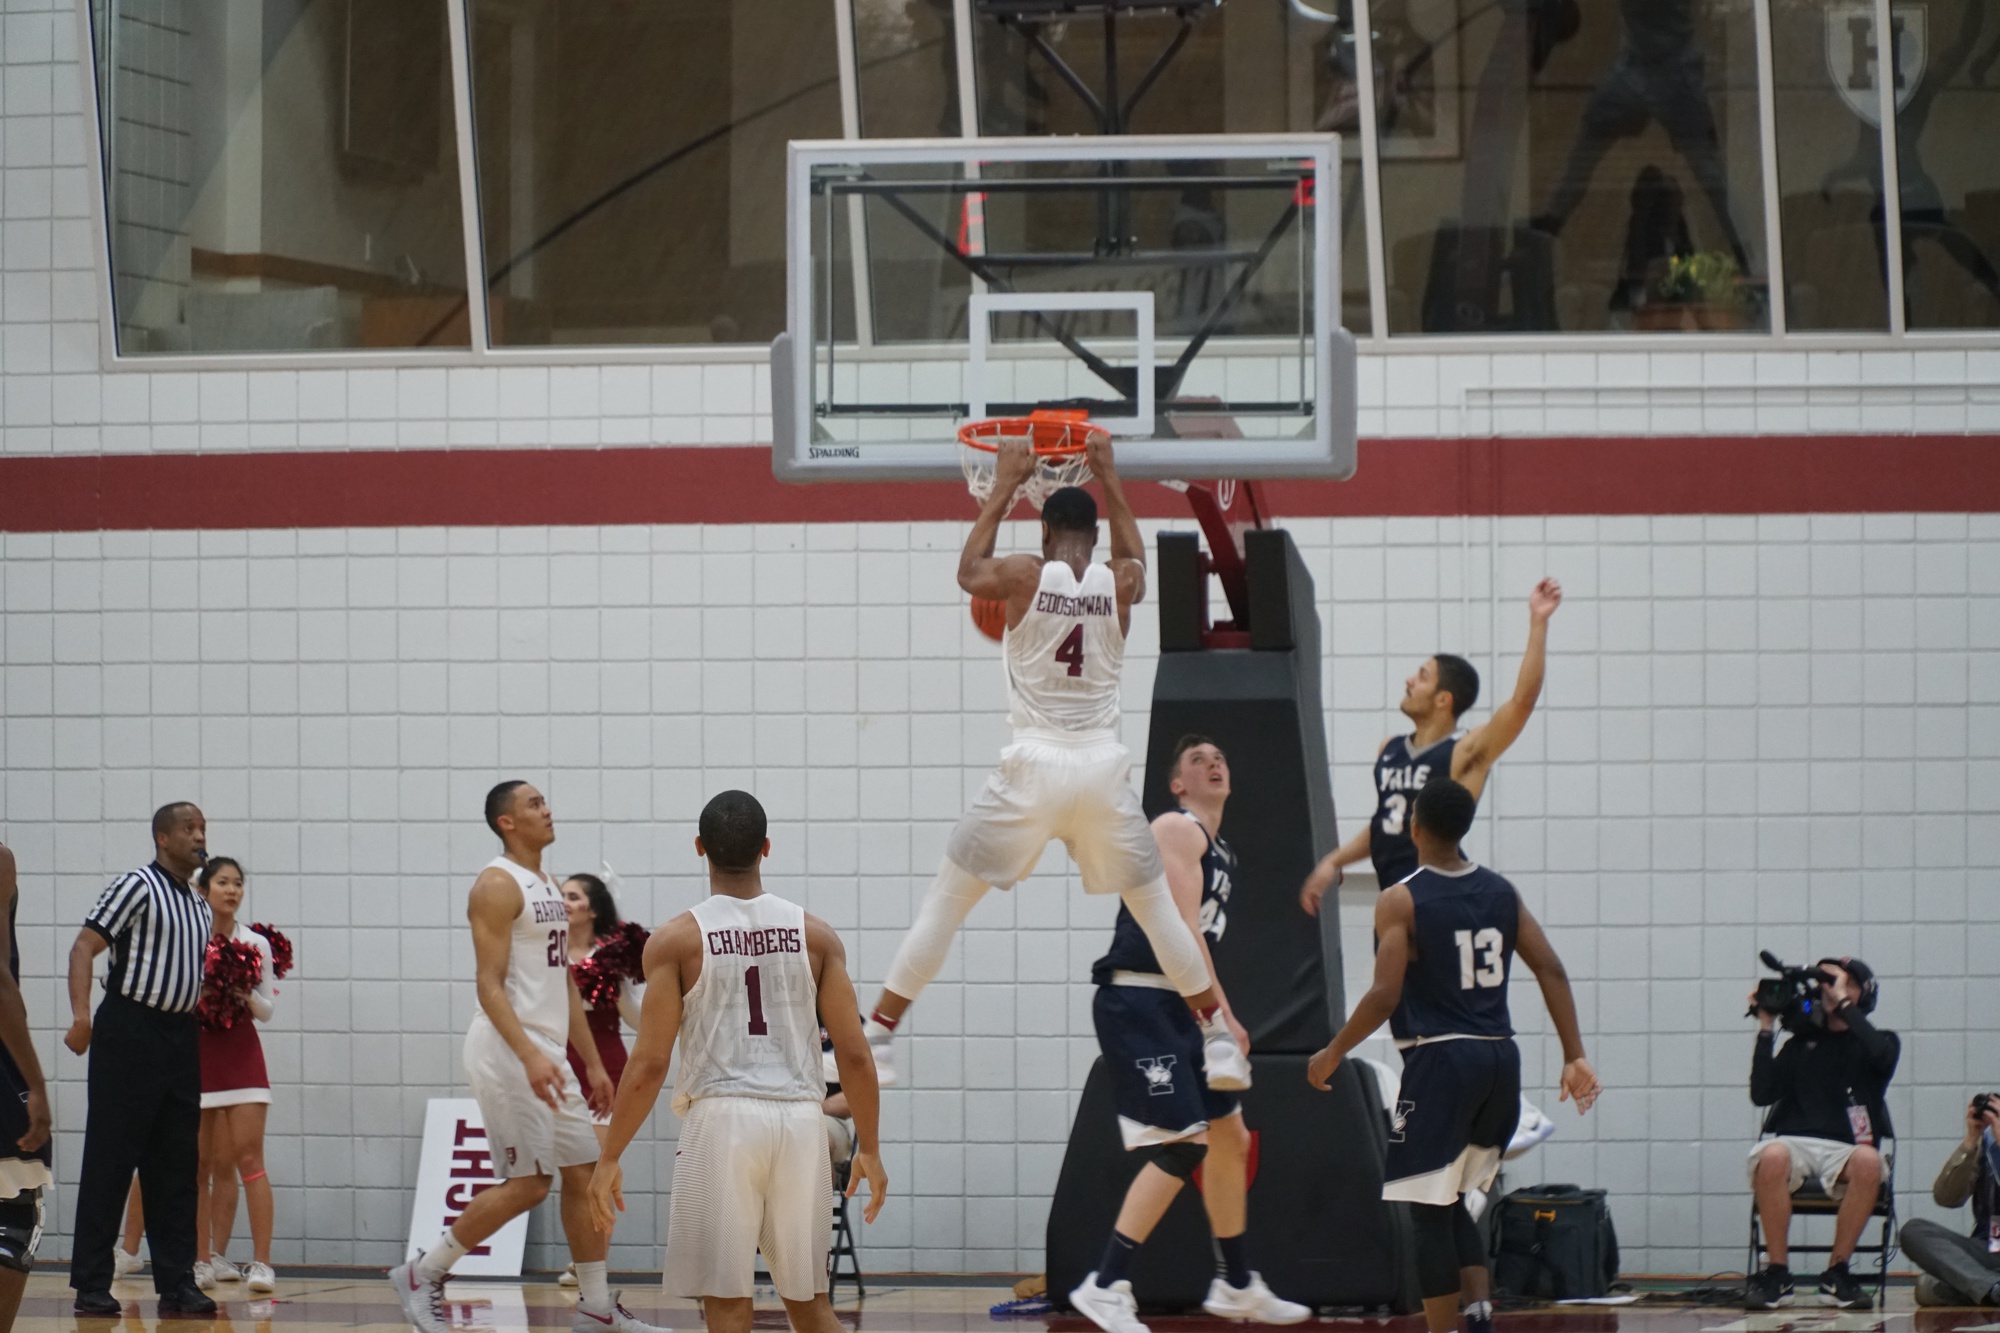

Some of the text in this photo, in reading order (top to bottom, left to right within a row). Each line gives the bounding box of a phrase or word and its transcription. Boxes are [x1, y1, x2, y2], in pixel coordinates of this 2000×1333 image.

[809, 447, 859, 459] SPALDING
[1055, 623, 1084, 677] 4
[1380, 764, 1431, 792] YALE
[707, 928, 801, 956] CHAMBERS
[1455, 927, 1504, 990] 13
[745, 965, 768, 1036] 1
[442, 1119, 498, 1257] GHT
